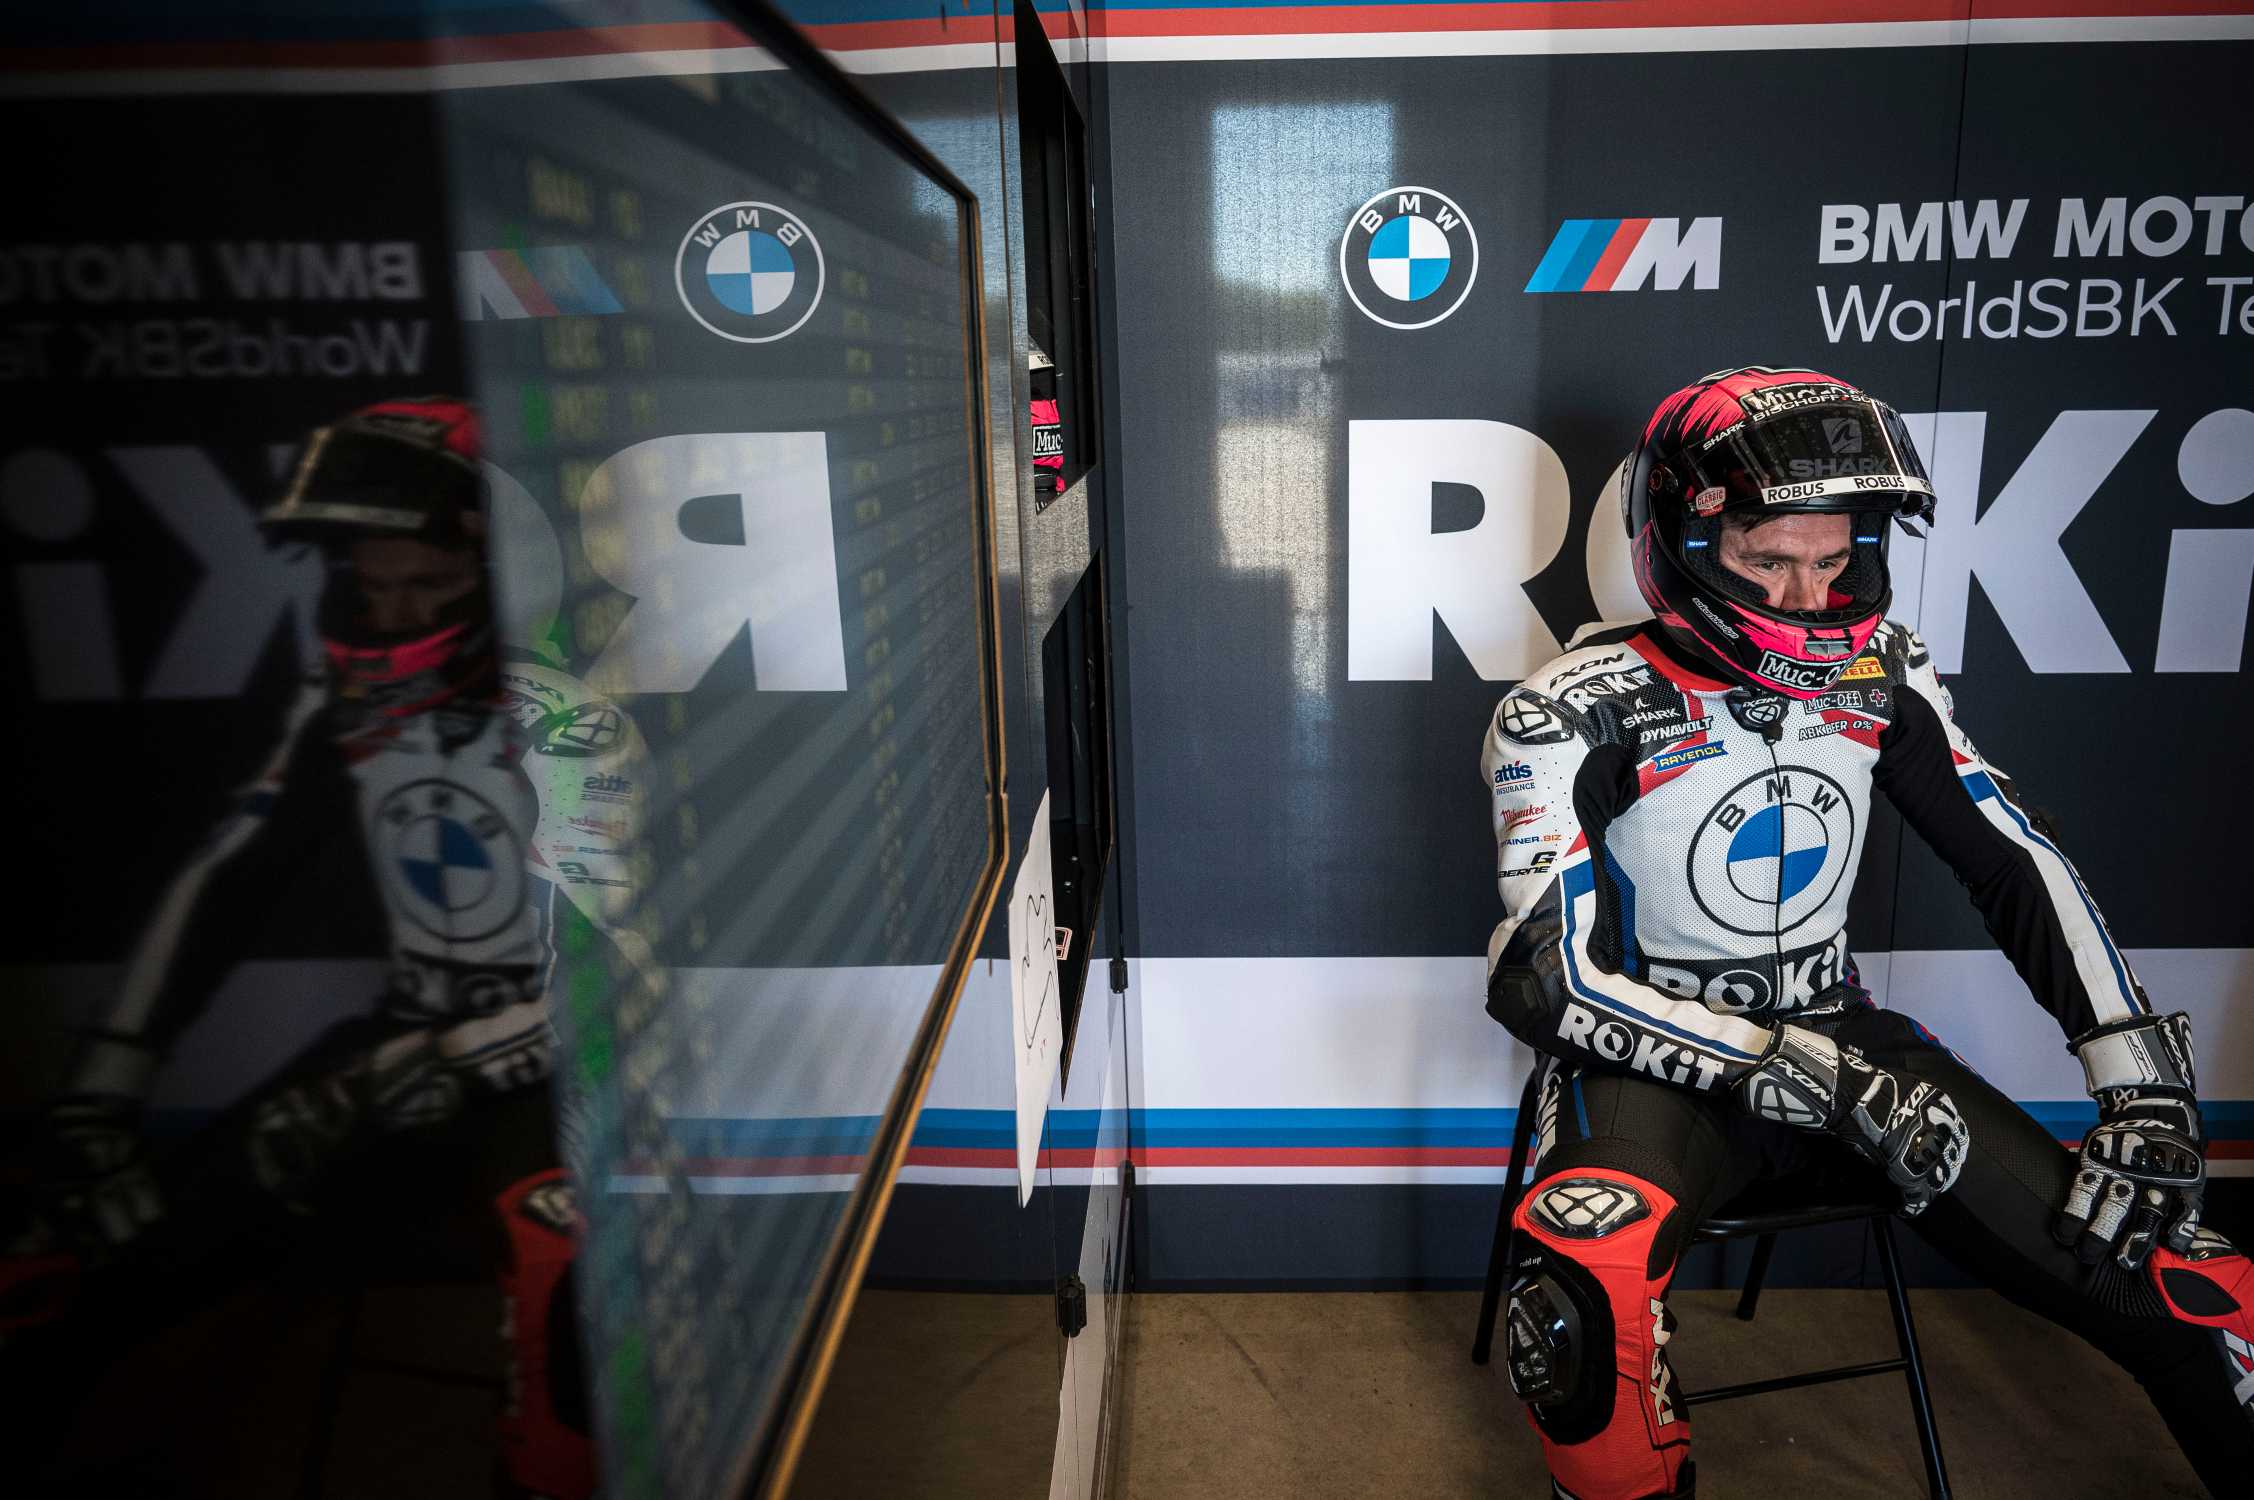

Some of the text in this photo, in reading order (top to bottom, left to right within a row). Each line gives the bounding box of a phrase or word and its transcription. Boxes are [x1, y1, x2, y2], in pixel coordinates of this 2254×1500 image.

[1359, 194, 1460, 234] BMW
[1819, 196, 2254, 264] BMW MOT
[1609, 217, 1723, 291] M
[1816, 277, 2254, 343] WorldSBK T
[1702, 421, 1746, 451] SHARK
[1788, 456, 1889, 480] SHARK
[1767, 483, 1825, 502] ROBUS
[1855, 476, 1905, 490] ROBUS
[1550, 652, 1625, 690] IXON
[1808, 692, 1860, 711] Muc-Off
[1622, 708, 1681, 729] SHARK
[1639, 716, 1714, 745] DYNAVOLT
[1659, 744, 1722, 768] RAVENOL
[1495, 760, 1532, 783] attis
[1715, 775, 1840, 833] BMW
[1557, 1002, 1726, 1091] ROKiT
